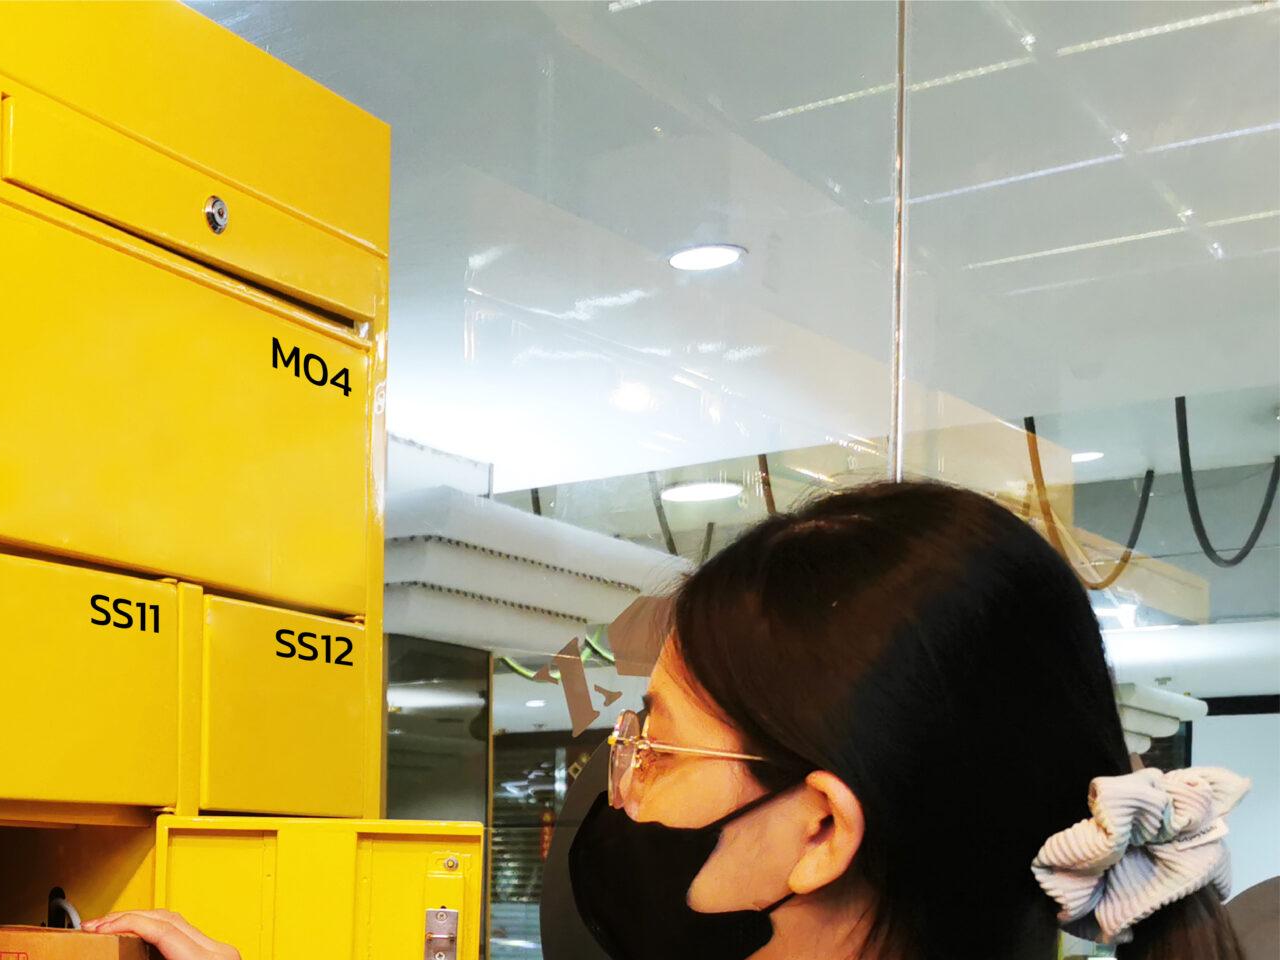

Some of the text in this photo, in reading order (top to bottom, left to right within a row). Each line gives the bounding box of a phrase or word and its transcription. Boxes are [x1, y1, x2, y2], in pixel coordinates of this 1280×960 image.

[272, 336, 352, 397] M04
[90, 594, 160, 634] SS11
[275, 628, 354, 667] SS12
